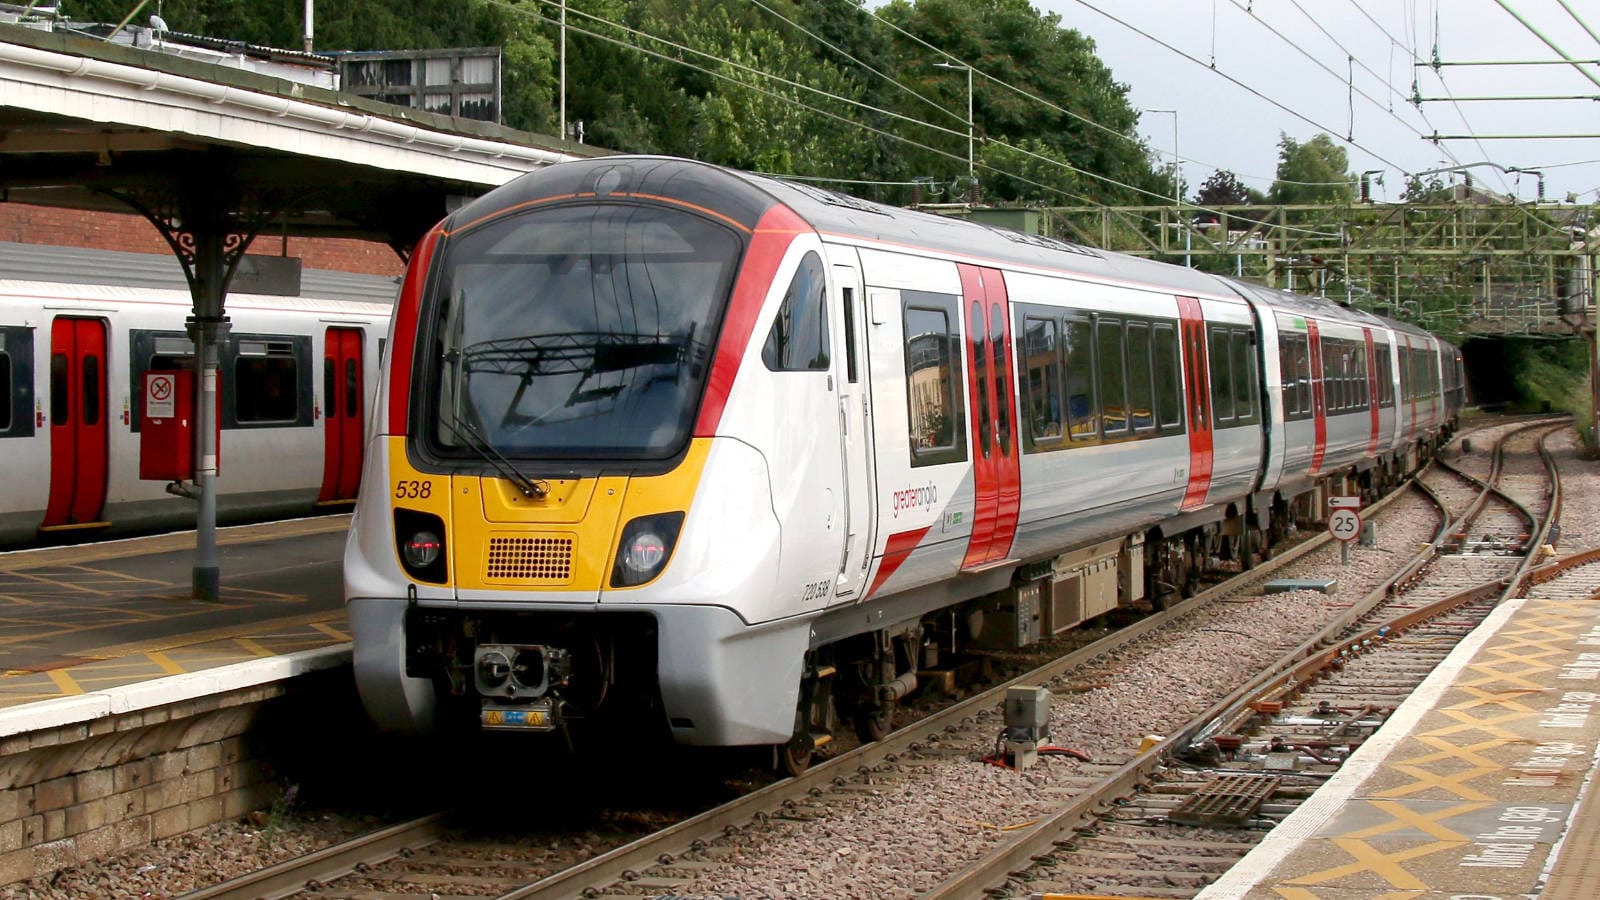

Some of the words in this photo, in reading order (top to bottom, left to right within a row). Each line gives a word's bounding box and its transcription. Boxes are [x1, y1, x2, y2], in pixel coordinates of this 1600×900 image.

[395, 480, 432, 499] 538
[1334, 516, 1355, 532] 25
[1498, 806, 1562, 823] gap
[1475, 825, 1544, 840] the
[1459, 842, 1536, 868] Mind
